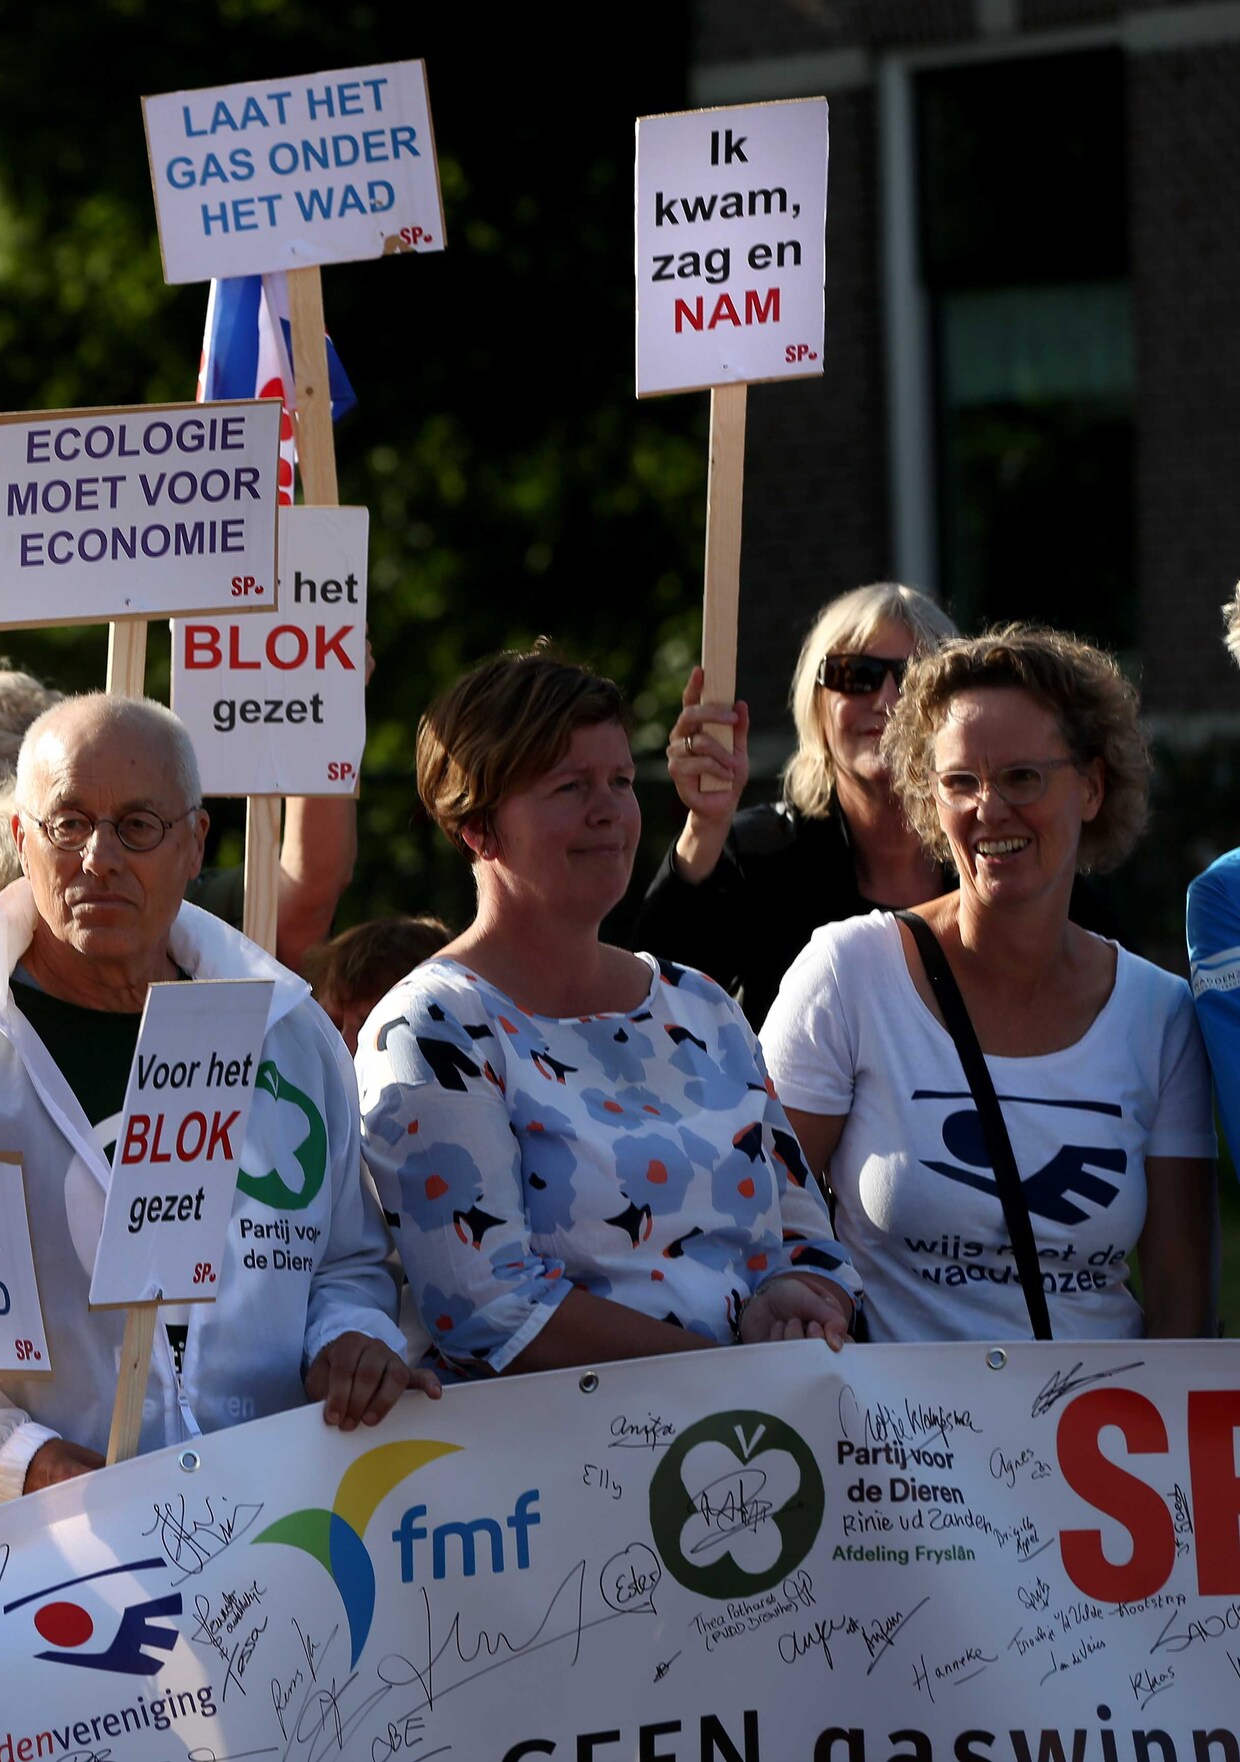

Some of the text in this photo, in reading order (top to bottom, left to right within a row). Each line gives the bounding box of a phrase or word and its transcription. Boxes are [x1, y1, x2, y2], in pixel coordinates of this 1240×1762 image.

[182, 78, 388, 138] LAAT HET
[166, 126, 421, 190] GAS ONDER
[710, 129, 749, 166] Ik
[201, 180, 396, 236] HET WAD
[655, 186, 801, 227] kwam,
[651, 239, 802, 284] zag en
[674, 287, 781, 334] NAM
[26, 416, 246, 464] ECOLOGIE
[6, 466, 261, 517] MOET VOOR
[20, 518, 246, 568] ECONOMIE
[293, 571, 358, 604] het
[184, 625, 357, 671] BLOK
[213, 692, 324, 733] gezet
[137, 1052, 253, 1091] Voor het
[120, 1110, 242, 1166] BLOK
[128, 1187, 205, 1233] gezet
[240, 1218, 291, 1245] Partij
[243, 1248, 268, 1269] de
[1088, 1244, 1126, 1267] de
[912, 1264, 1107, 1293] waddnzee
[837, 1440, 954, 1470] Partij voor
[847, 1477, 965, 1505] de Dieren
[392, 1489, 540, 1583] fmf
[832, 1545, 976, 1565] Afdeling Fryslân
